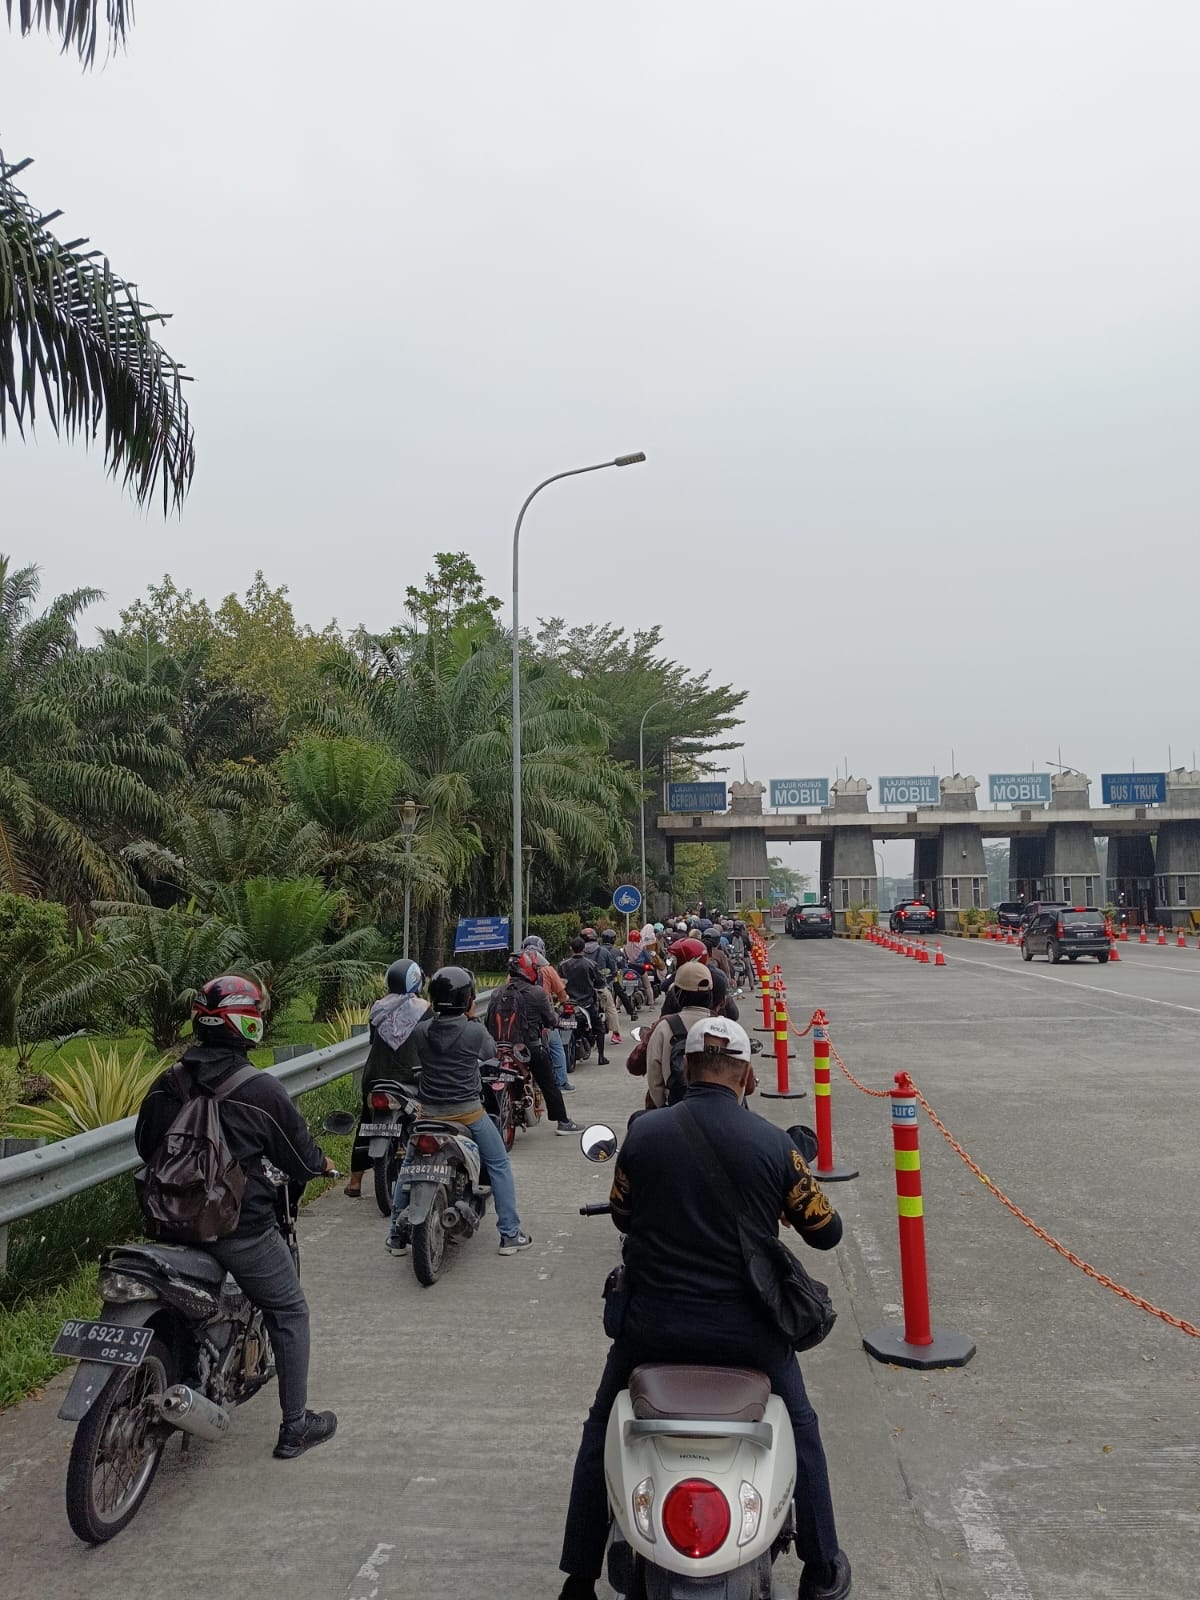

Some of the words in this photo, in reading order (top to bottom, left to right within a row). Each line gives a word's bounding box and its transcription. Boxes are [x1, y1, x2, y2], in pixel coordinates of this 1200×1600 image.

[775, 789, 825, 804] MOBIL
[883, 787, 935, 802] MOBIL
[993, 784, 1046, 800] MOBIL
[1110, 784, 1128, 800] BUS
[1134, 784, 1159, 800] TRUK
[671, 793, 698, 809] SEPEDA
[63, 1322, 84, 1338] BK
[88, 1325, 125, 1343] 6923
[130, 1331, 148, 1347] SI
